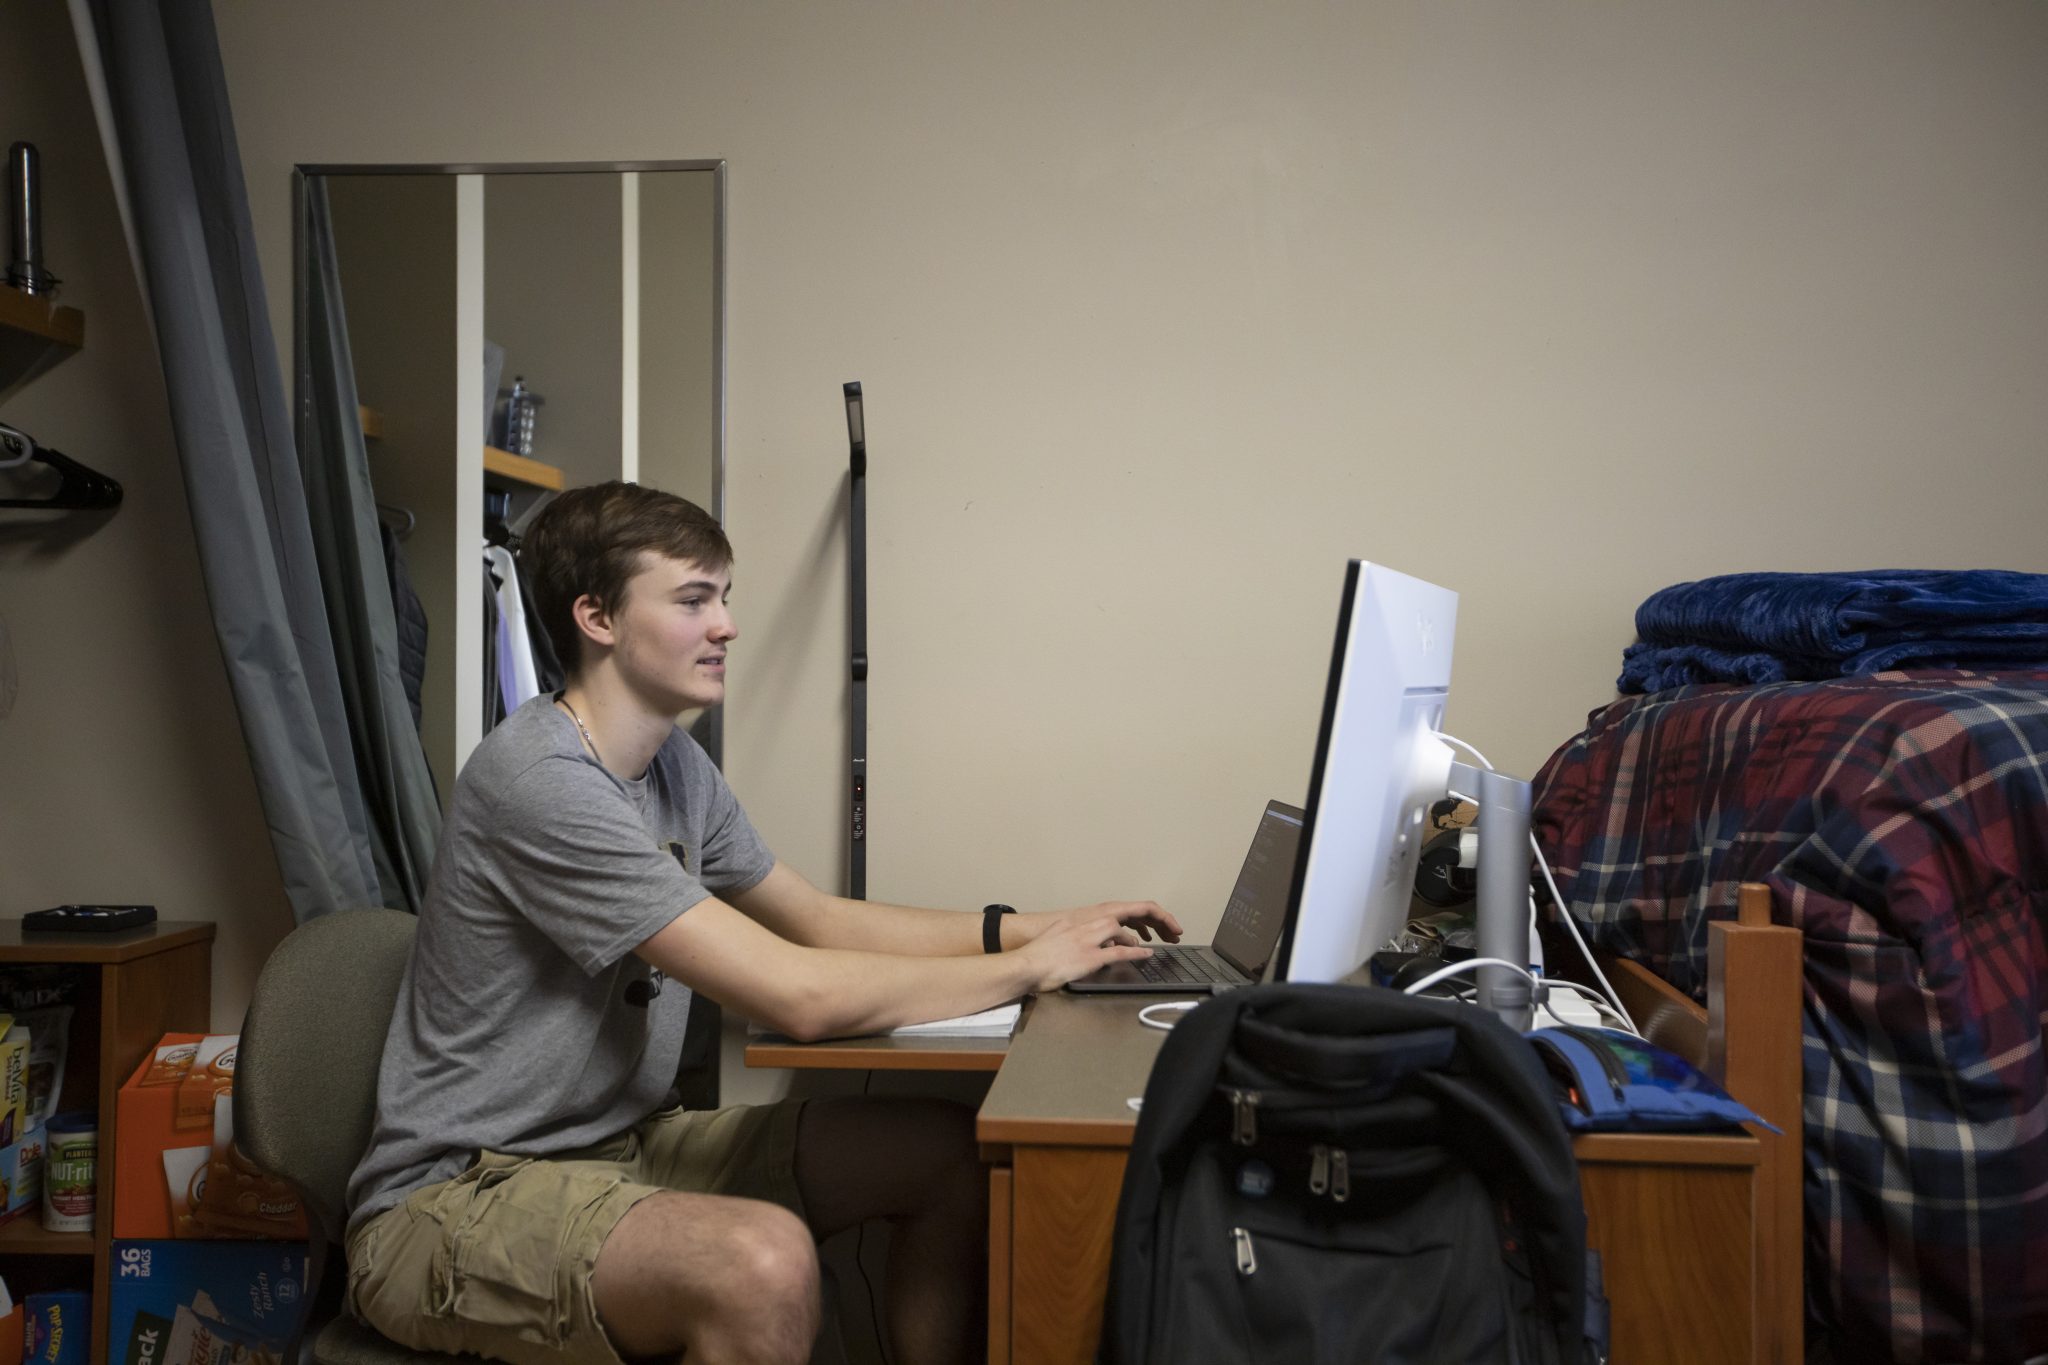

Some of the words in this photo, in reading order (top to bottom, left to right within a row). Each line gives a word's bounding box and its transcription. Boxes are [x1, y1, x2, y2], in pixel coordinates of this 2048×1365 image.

[10, 1046, 25, 1105] belVita
[20, 1142, 41, 1165] Dole
[259, 1201, 298, 1214] Cheddar
[120, 1247, 140, 1278] 36
[141, 1249, 152, 1278] BAGS
[250, 1282, 265, 1319] Zesty
[258, 1271, 275, 1312] Ranch
[278, 1284, 290, 1297] 12
[138, 1328, 159, 1365] ack
